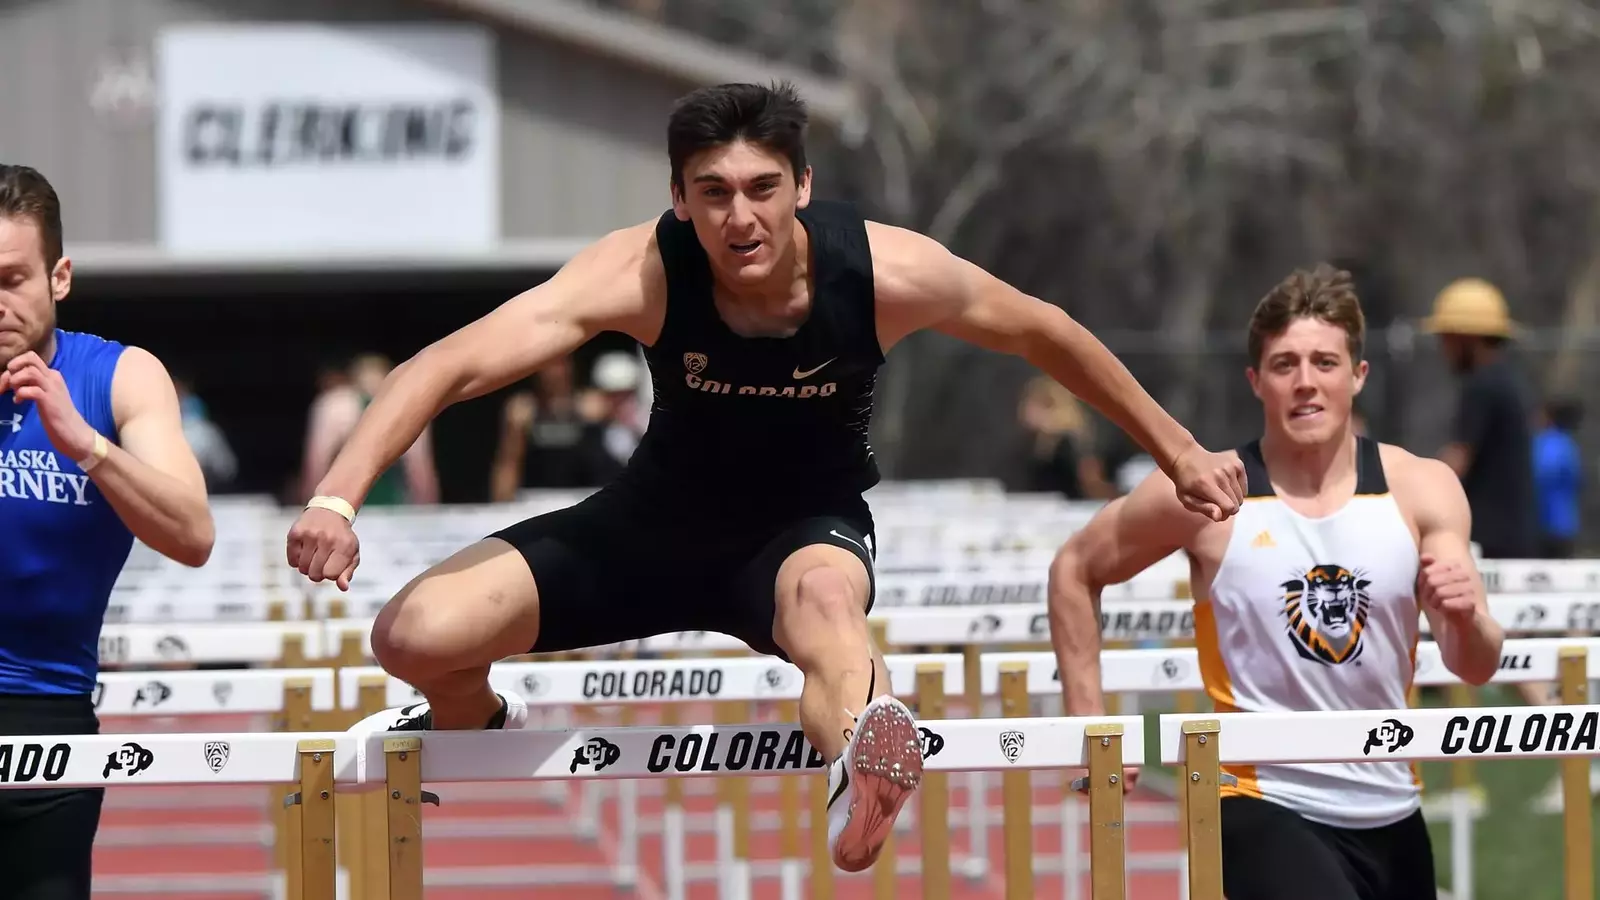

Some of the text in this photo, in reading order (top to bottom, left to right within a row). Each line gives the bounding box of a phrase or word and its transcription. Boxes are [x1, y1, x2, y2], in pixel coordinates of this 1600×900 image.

[184, 101, 476, 165] CLERKING
[1500, 655, 1532, 670] ILL
[583, 669, 723, 698] COLORADO
[206, 743, 229, 759] PAC
[647, 730, 826, 773] COLORA
[1001, 731, 1024, 749] PAC
